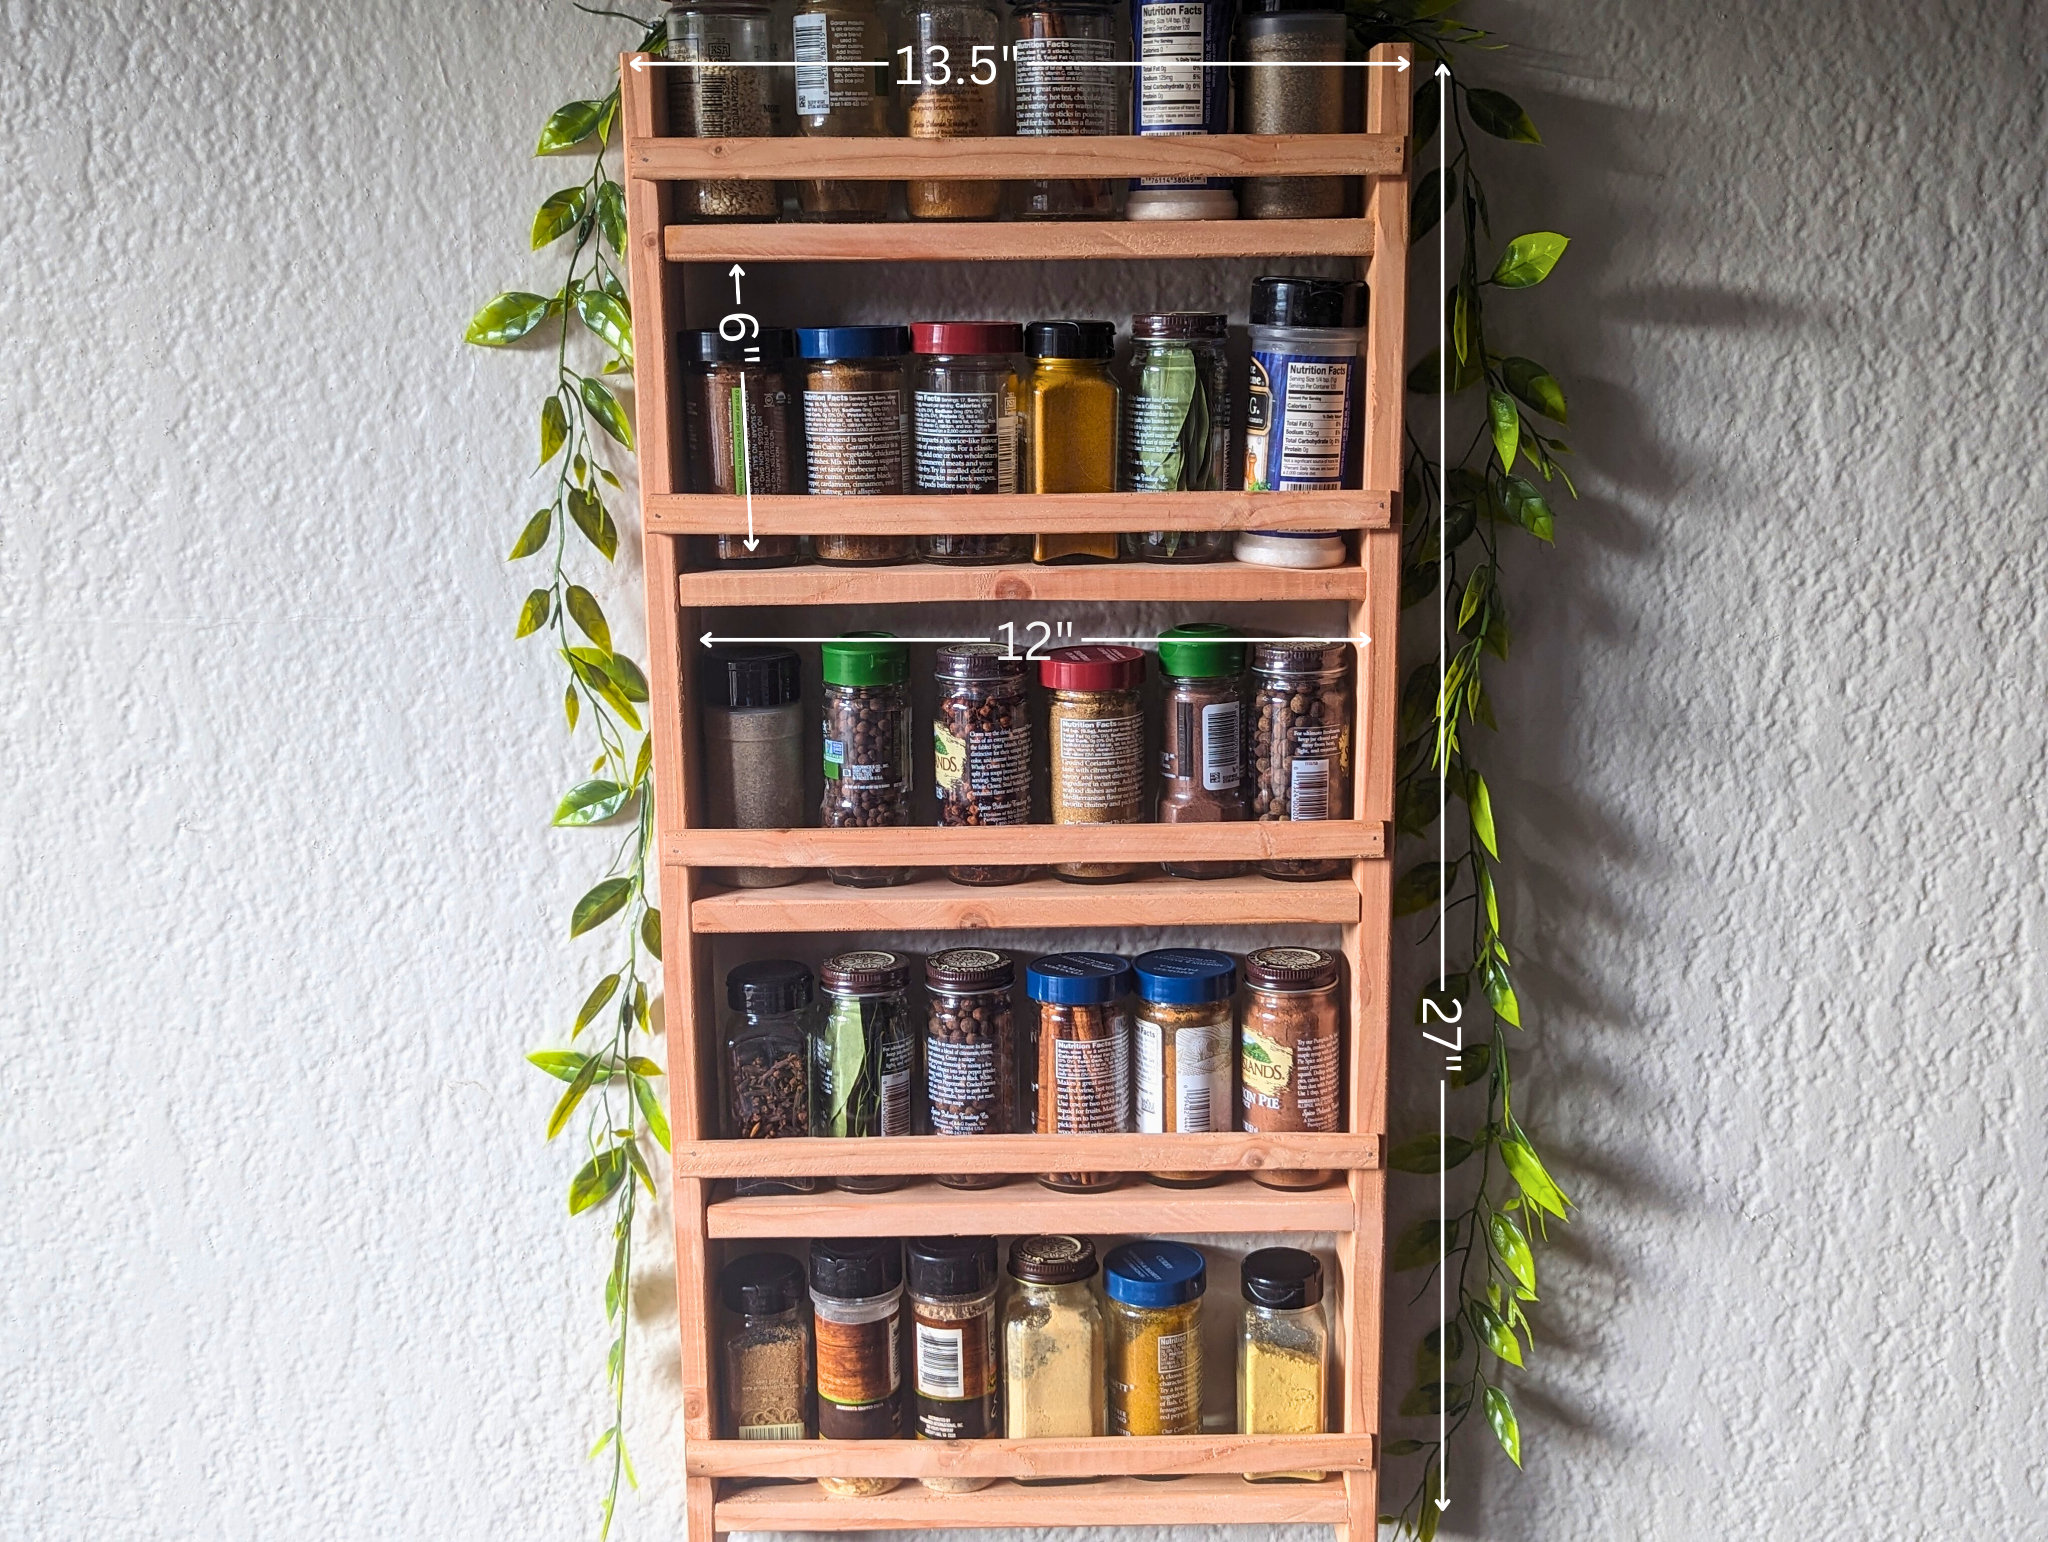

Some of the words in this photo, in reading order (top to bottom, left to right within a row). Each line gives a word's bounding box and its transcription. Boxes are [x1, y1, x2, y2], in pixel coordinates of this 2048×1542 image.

[1143, 6, 1176, 16] Nutrition
[1179, 5, 1201, 15] Facts
[1290, 365, 1326, 375] Nutrition
[1329, 366, 1345, 375] Facts
[1259, 1094, 1279, 1109] PIE
